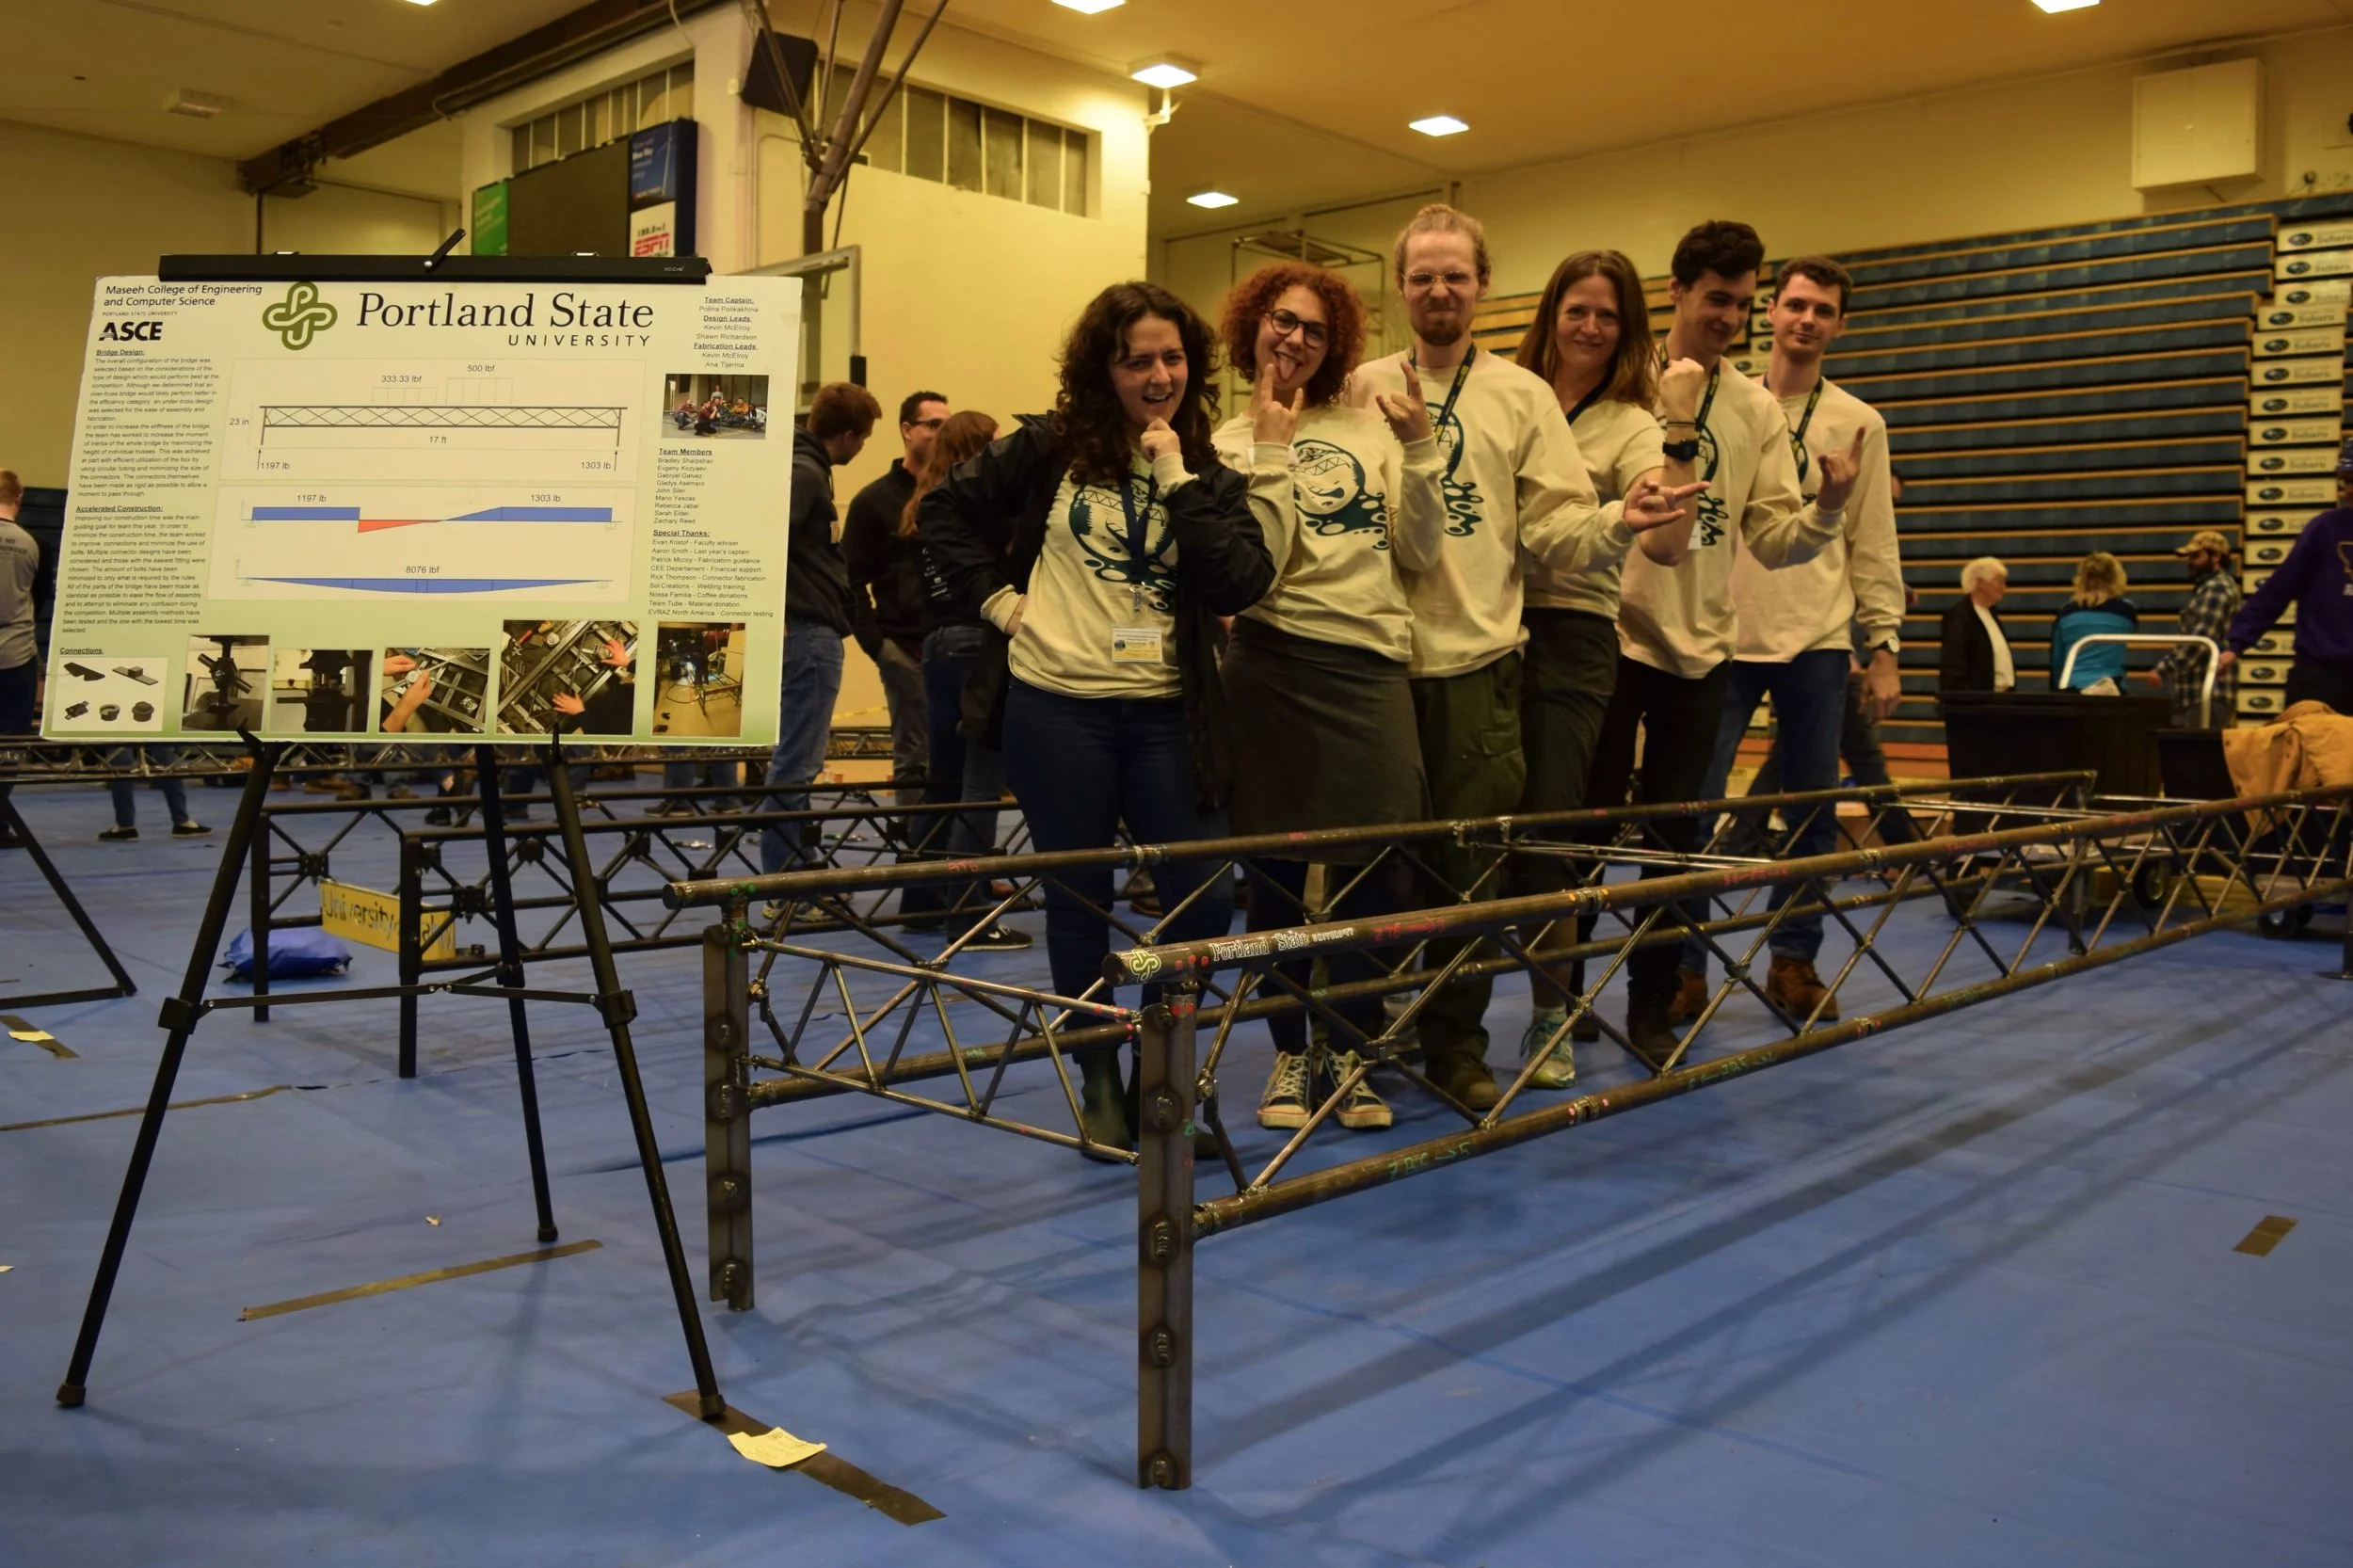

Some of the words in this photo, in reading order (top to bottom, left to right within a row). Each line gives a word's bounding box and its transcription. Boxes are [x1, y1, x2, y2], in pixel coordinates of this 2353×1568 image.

[105, 285, 144, 295] Maseeh
[148, 285, 184, 296] College
[188, 285, 199, 294] of
[201, 285, 262, 296] Engineering
[126, 297, 176, 307] Computer
[357, 293, 535, 328] Portland
[550, 292, 654, 328] State
[99, 322, 163, 341] ASCE
[508, 334, 651, 347] UNIVERSITY
[467, 364, 481, 373] 500
[381, 375, 410, 383] 333.33
[281, 461, 290, 470] lb
[601, 461, 611, 470] lb
[296, 494, 316, 503] 1197
[318, 494, 327, 503] lb
[531, 494, 551, 503] 1303
[552, 494, 561, 503] lb
[406, 566, 426, 574] 8076
[428, 566, 440, 574] lbf
[1209, 936, 1270, 962] Portland
[1274, 930, 1310, 952] State
